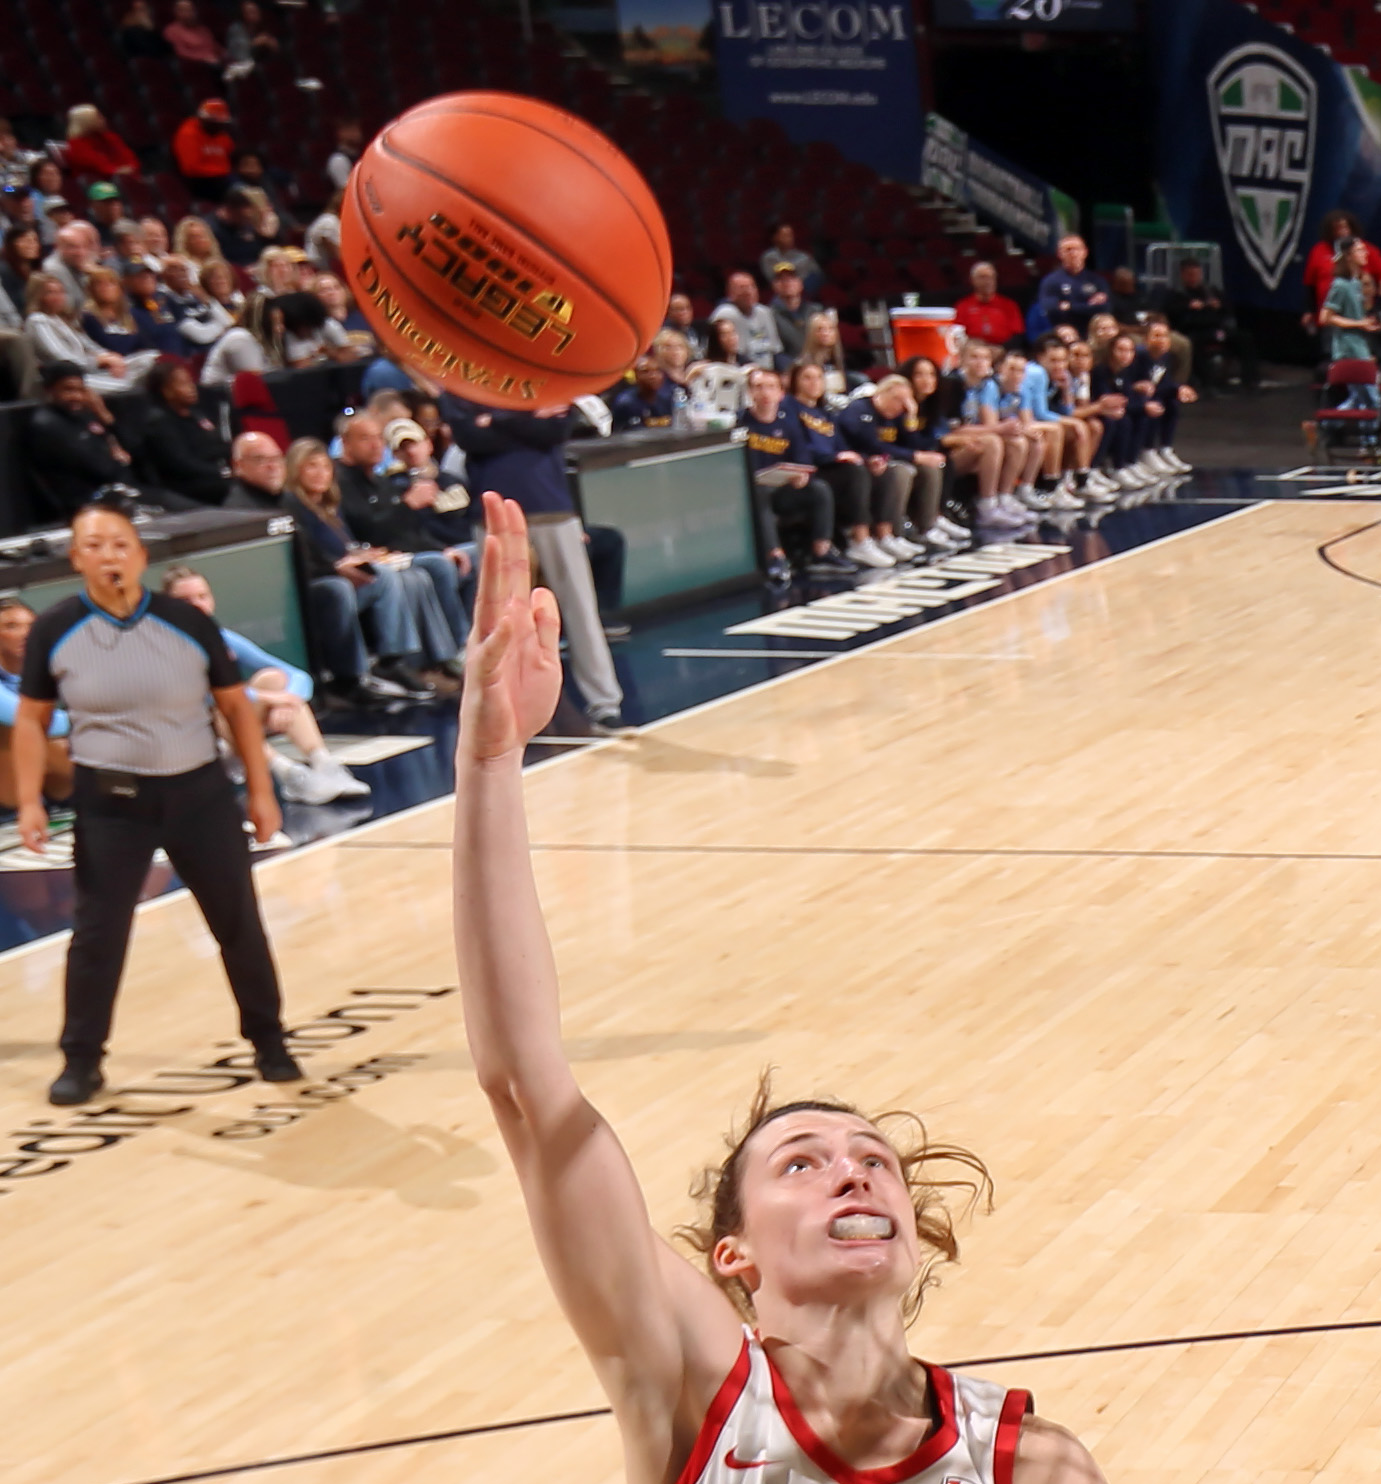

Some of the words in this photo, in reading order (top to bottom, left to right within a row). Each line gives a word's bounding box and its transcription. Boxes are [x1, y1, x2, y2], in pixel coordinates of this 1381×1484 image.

[719, 4, 907, 40] LECOM
[1205, 124, 1311, 184] MAC
[355, 255, 547, 400] SPALDING
[397, 219, 577, 357] LEGACY
